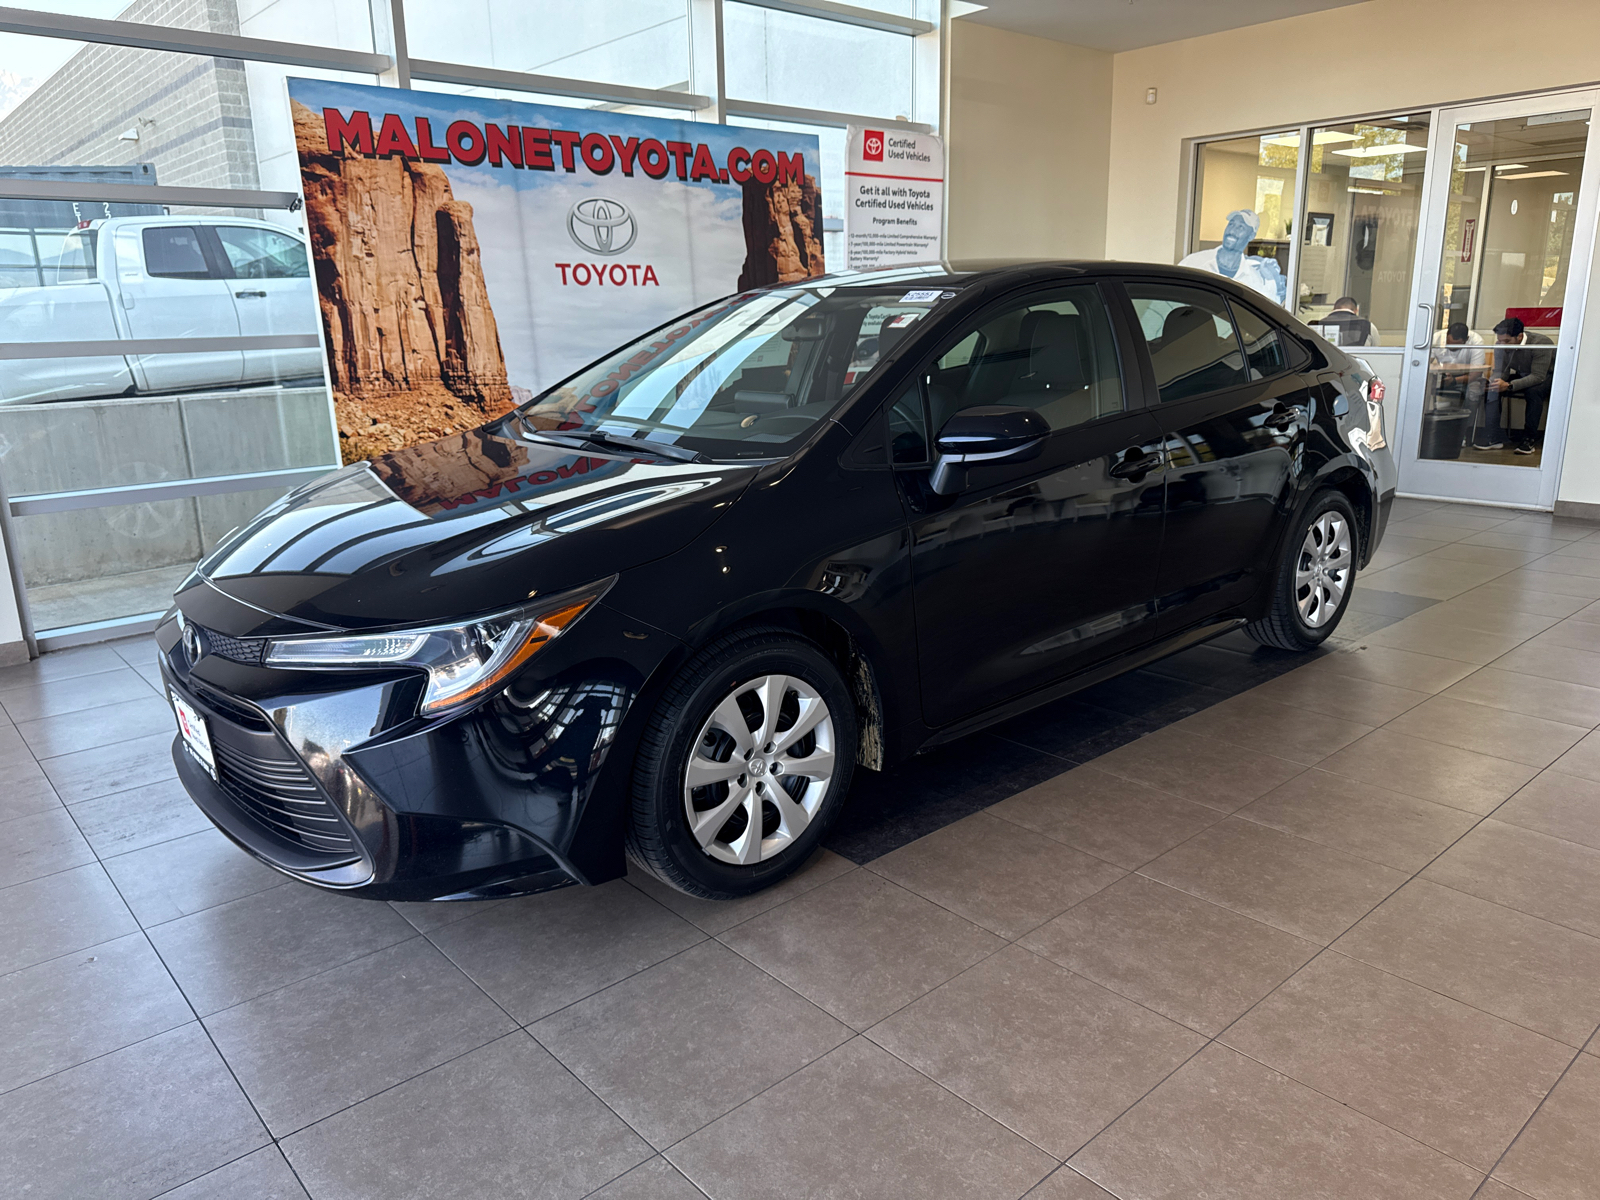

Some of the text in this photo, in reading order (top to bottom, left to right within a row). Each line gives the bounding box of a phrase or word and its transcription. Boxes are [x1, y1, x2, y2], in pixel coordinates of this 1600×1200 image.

[322, 107, 804, 187] MALONETOYOTA.COM
[888, 137, 916, 149] Certified
[888, 149, 931, 162] Used Vehicles
[860, 185, 931, 200] Get it all with Toyota
[855, 198, 934, 211] Certified Used Vehicles
[872, 217, 917, 226] Program Benefits
[554, 262, 660, 287] TOYOTA
